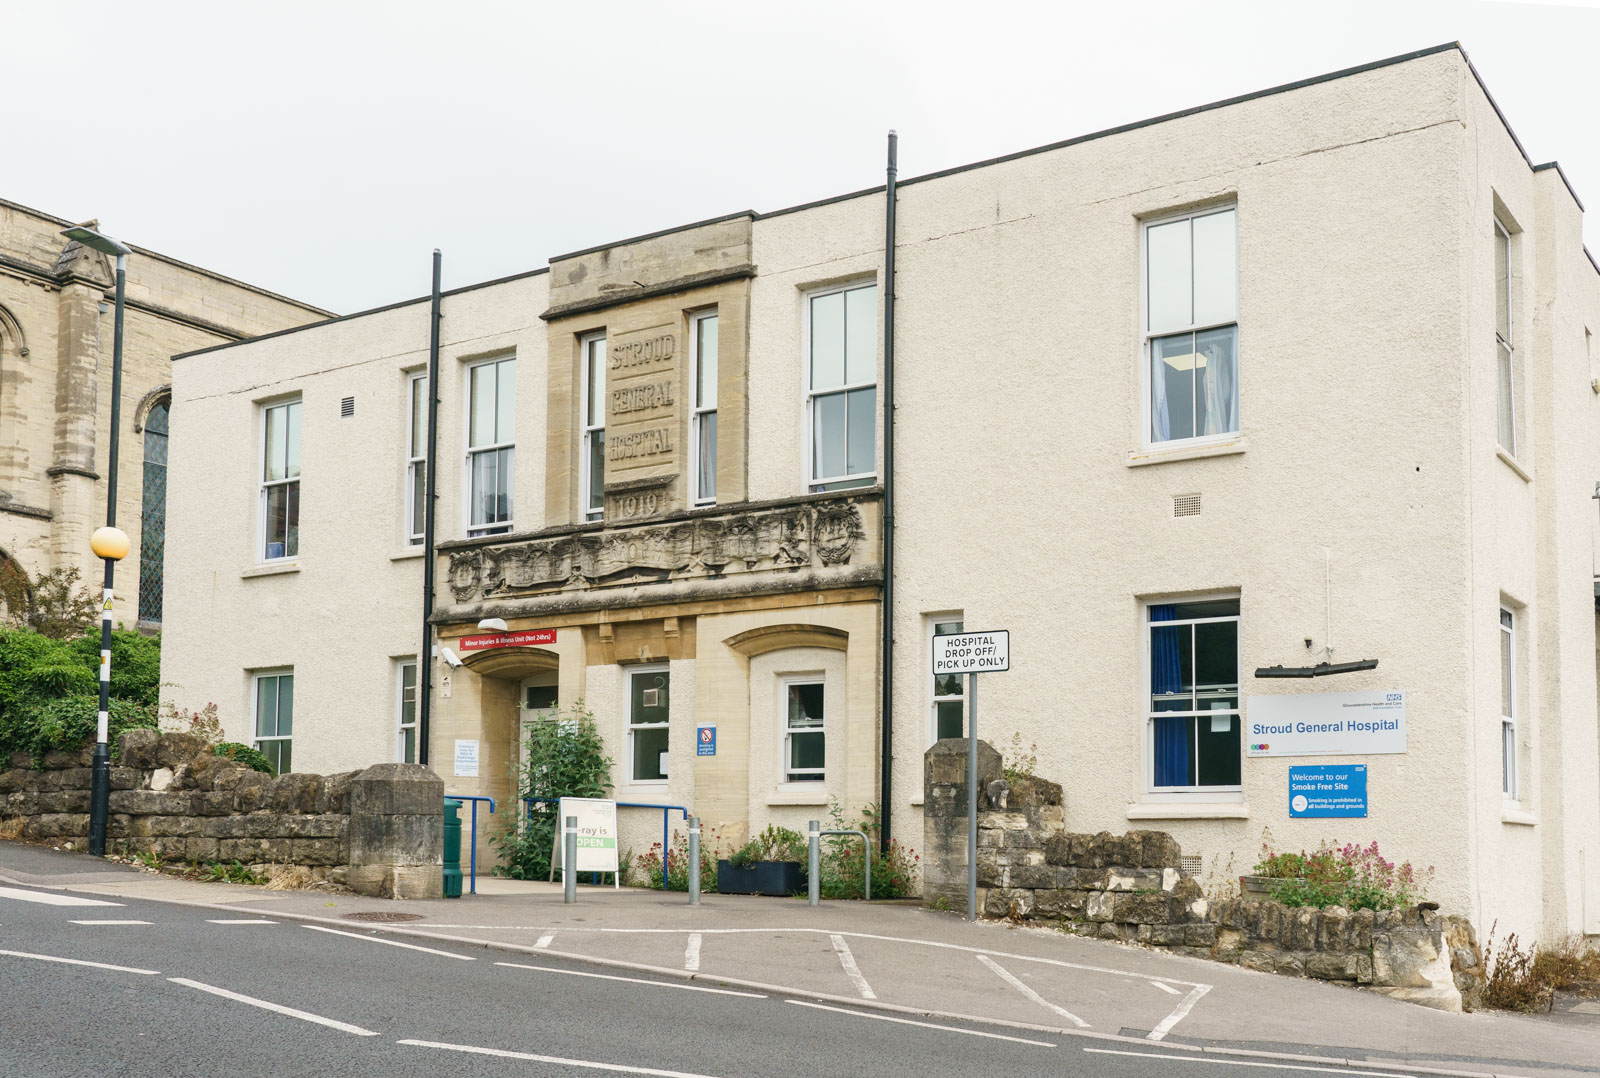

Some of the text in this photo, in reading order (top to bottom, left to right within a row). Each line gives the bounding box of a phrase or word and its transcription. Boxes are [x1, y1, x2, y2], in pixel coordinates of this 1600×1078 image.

[611, 334, 675, 370] STROUD
[611, 381, 675, 415] GENERAL
[609, 428, 674, 462] HOSPITAL
[617, 492, 660, 519] 1919
[479, 638, 494, 647] Injuries
[536, 633, 551, 641] 24hrs)
[947, 636, 995, 647] HOSPITAL
[945, 646, 997, 658] DROP OFF/
[937, 657, 1005, 669] PICK UP ONLY
[1253, 719, 1399, 735] Stroud General Hospital
[1292, 773, 1324, 781] Welcome
[1292, 783, 1316, 791] Smoke
[1334, 782, 1349, 790] Site
[578, 826, 608, 836] -ray is
[577, 838, 604, 847] OPEN
